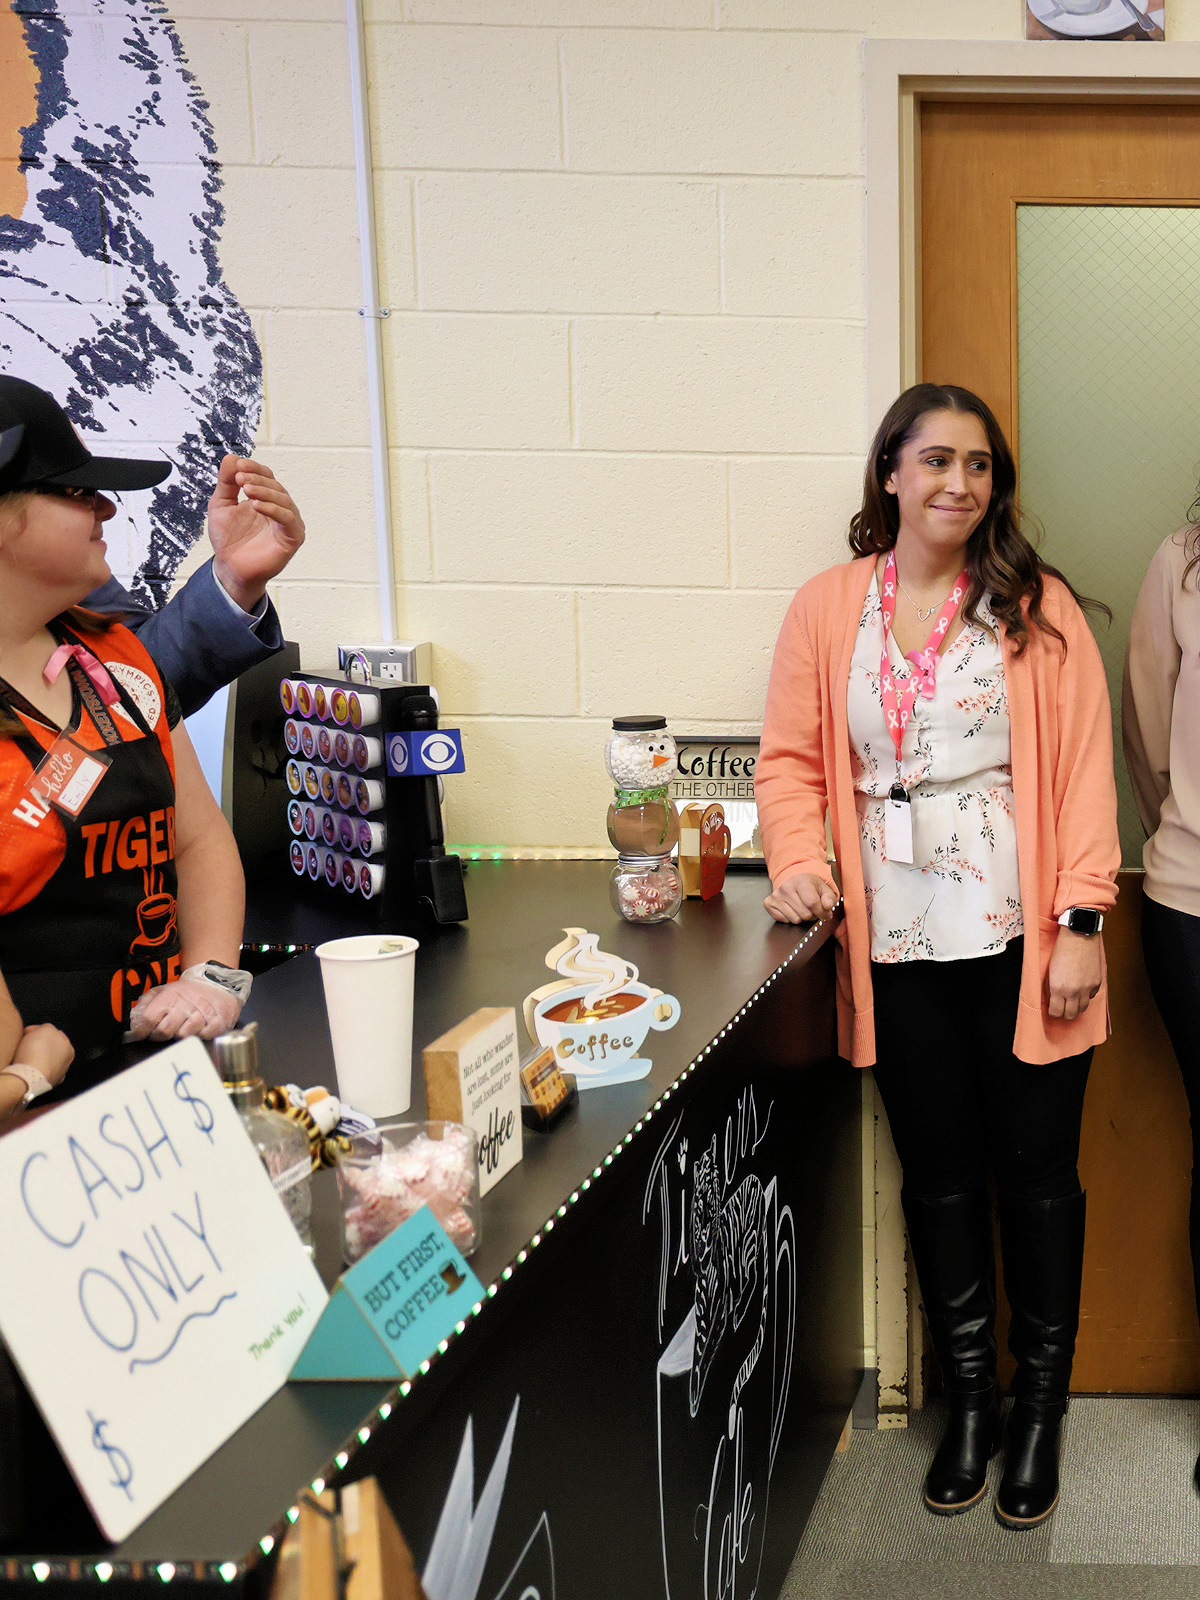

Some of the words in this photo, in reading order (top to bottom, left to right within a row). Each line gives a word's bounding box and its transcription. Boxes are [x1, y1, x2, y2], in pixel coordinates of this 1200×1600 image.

[108, 664, 156, 697] OLYMPICS
[41, 751, 74, 798] hello
[677, 746, 756, 778] Coffee
[673, 782, 702, 797] THE
[706, 782, 755, 797] OTHER
[474, 1056, 483, 1071] all
[482, 1049, 494, 1065] who
[556, 1033, 634, 1062] Coffee
[483, 1077, 503, 1104] looking
[503, 1071, 511, 1085] for
[20, 1089, 183, 1249] CASH
[171, 1062, 215, 1145] $
[78, 1191, 223, 1353] ONLY
[363, 1270, 401, 1314] BUT
[384, 1272, 445, 1341] COFFEE
[86, 1408, 135, 1501] $
